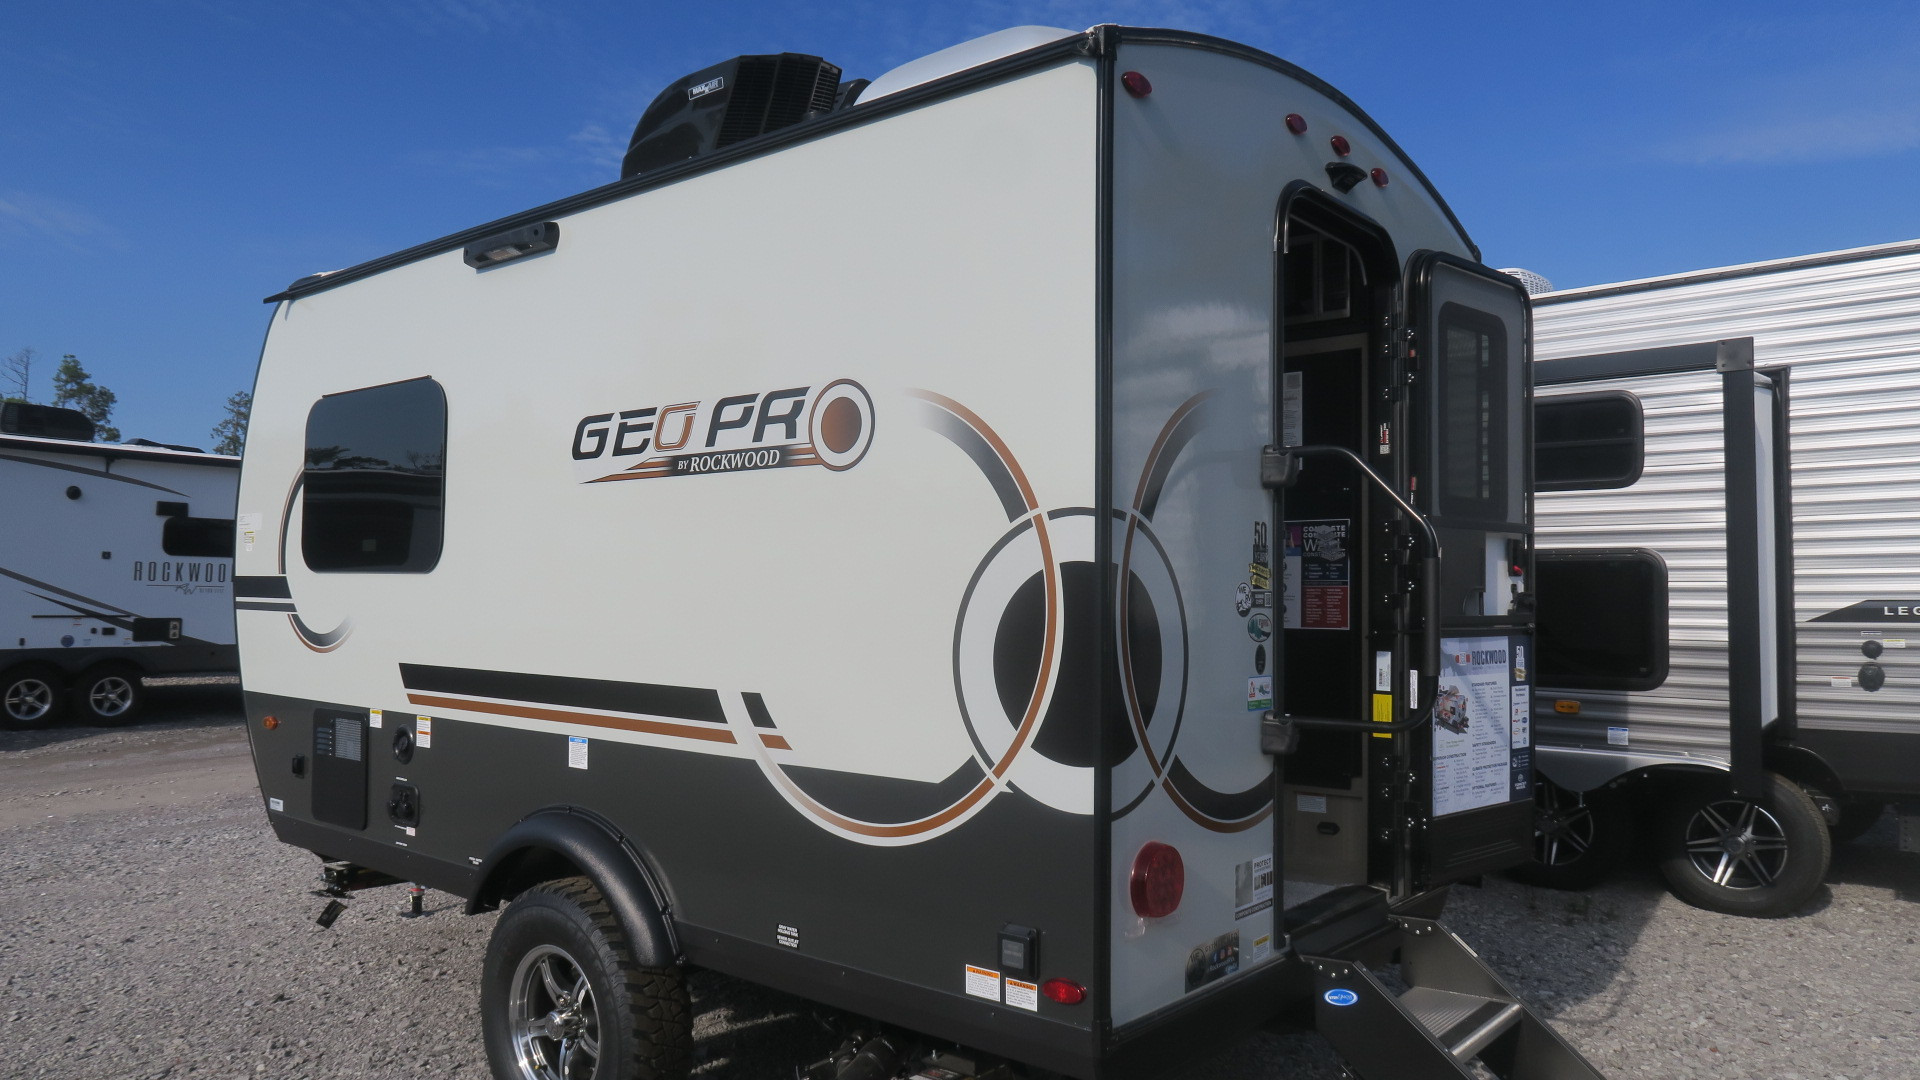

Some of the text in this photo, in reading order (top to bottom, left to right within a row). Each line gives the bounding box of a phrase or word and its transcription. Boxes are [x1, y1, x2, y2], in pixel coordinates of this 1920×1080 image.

[571, 401, 701, 460] GEO
[677, 449, 780, 472] BY ROCKWOOD
[1255, 521, 1267, 548] 50
[134, 561, 232, 583] ROCKWOO
[1472, 650, 1506, 665] ROCKWOOD
[1254, 857, 1271, 869] PROTECT
